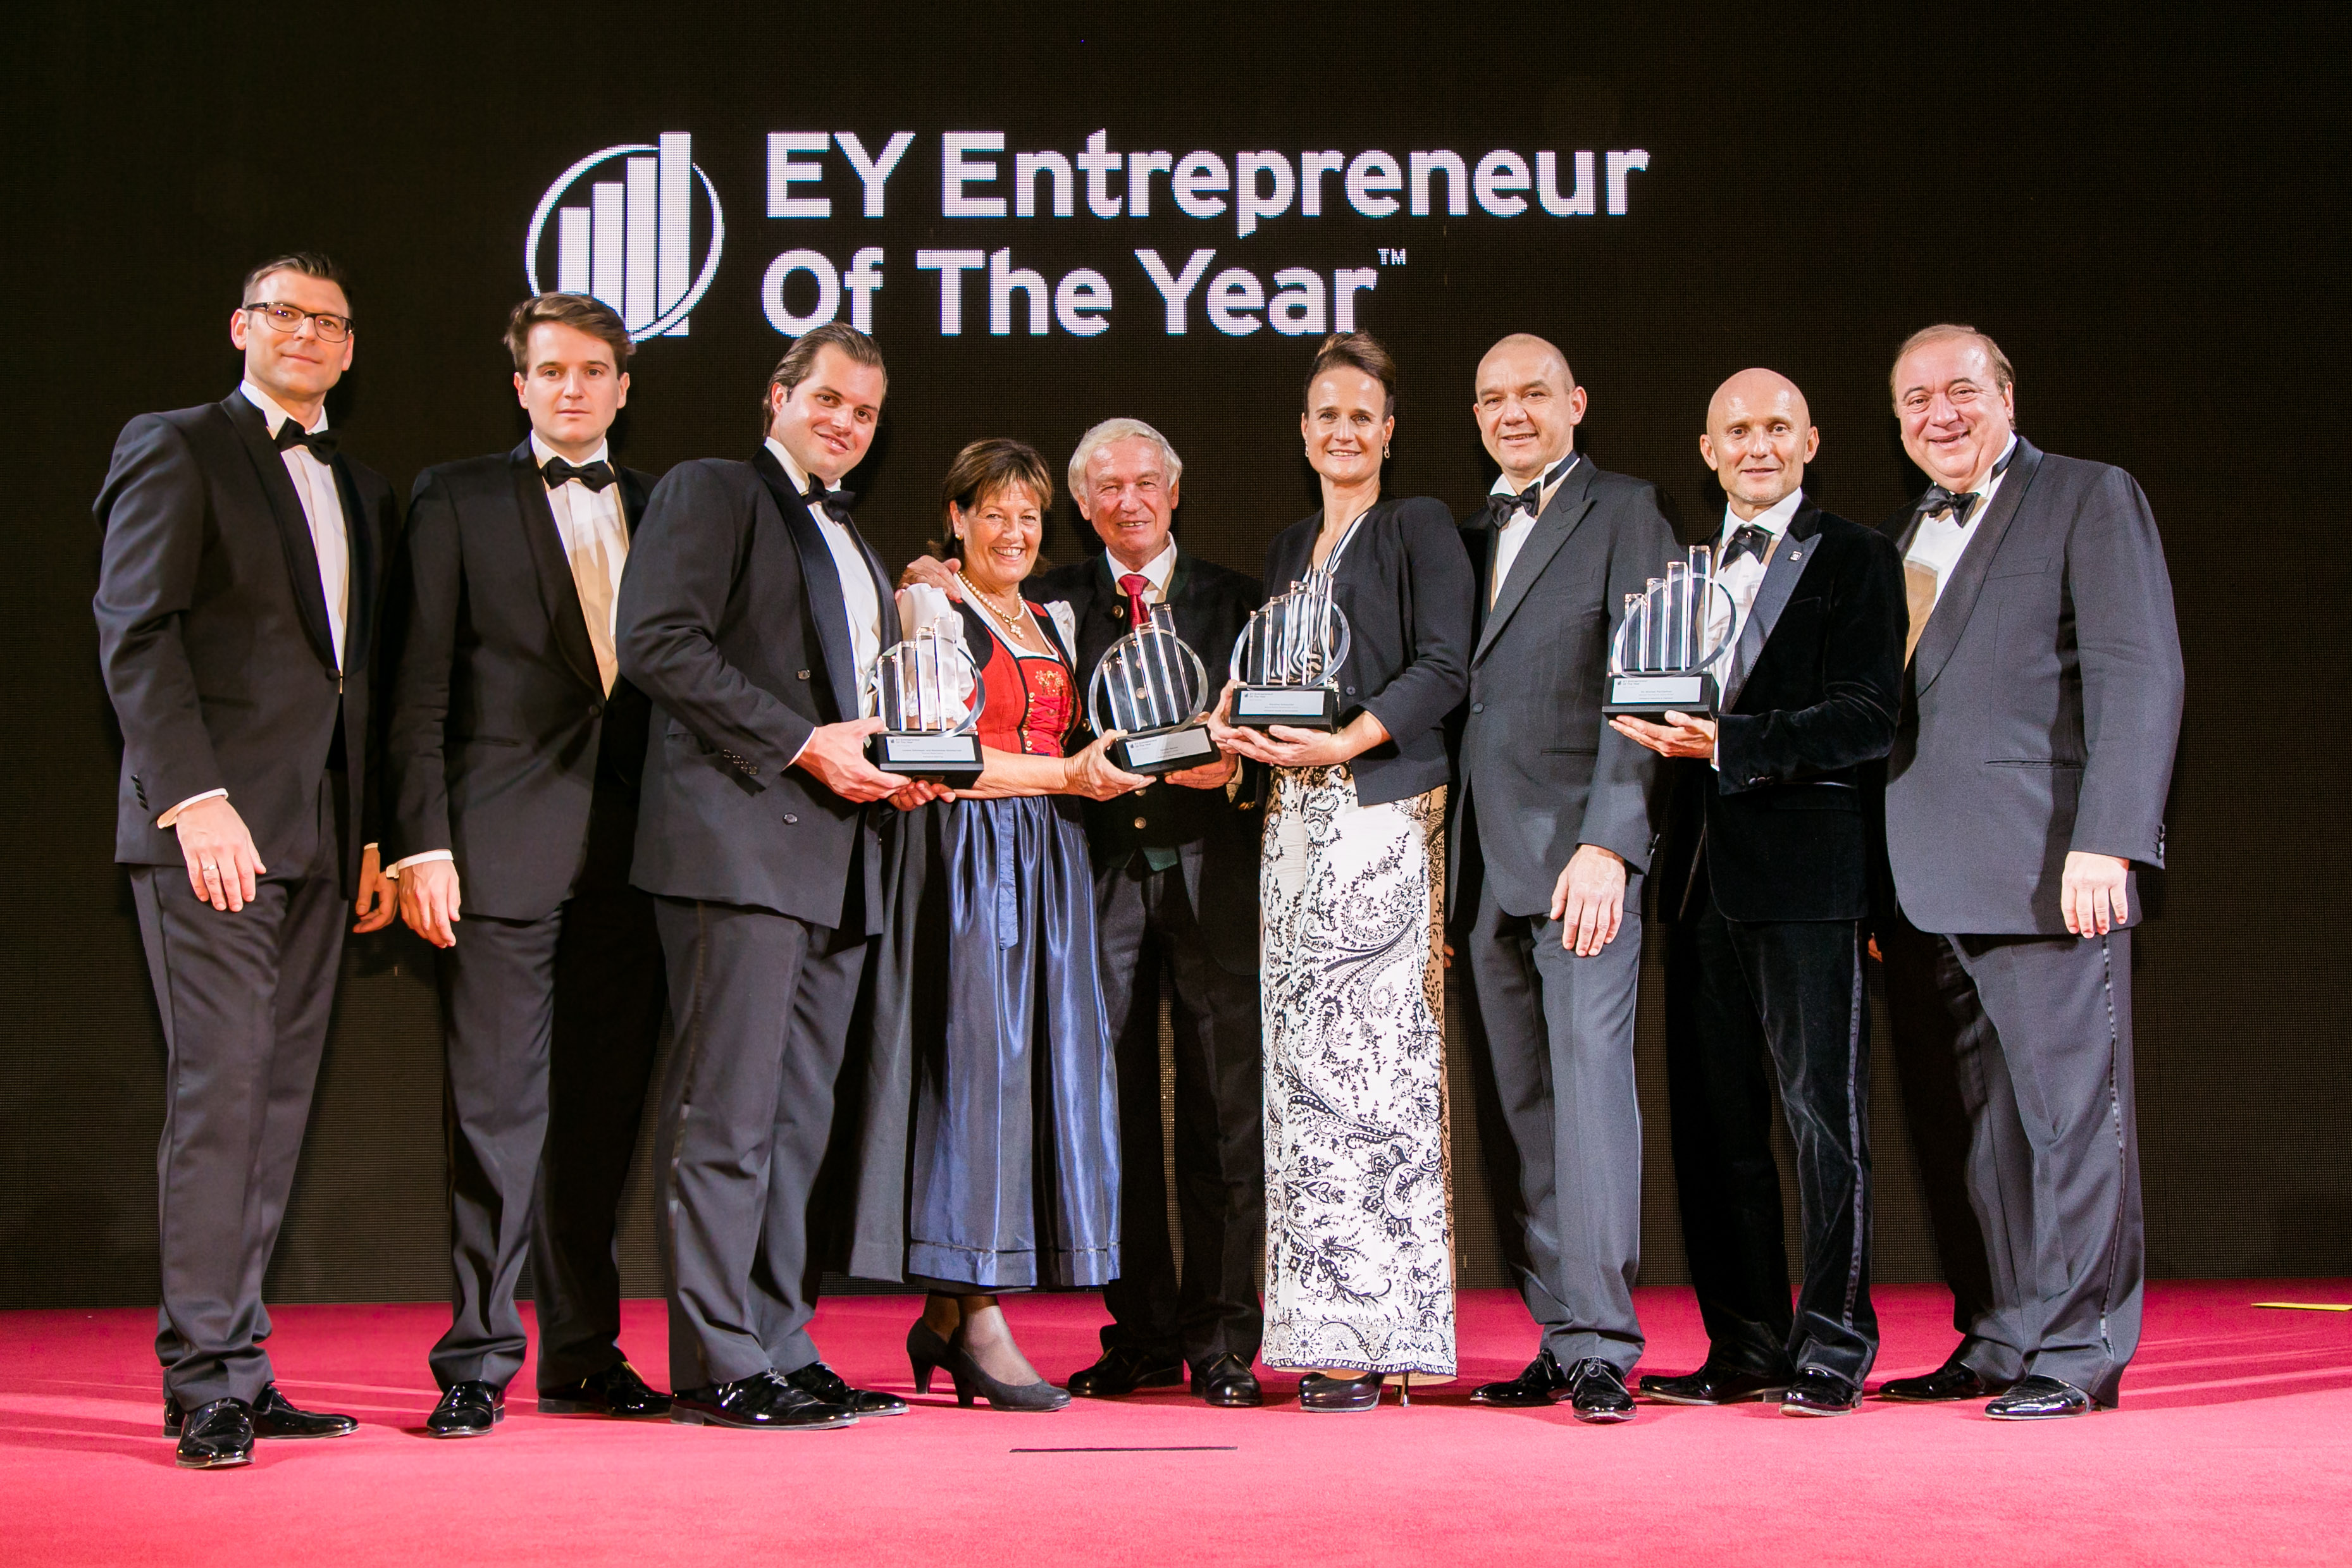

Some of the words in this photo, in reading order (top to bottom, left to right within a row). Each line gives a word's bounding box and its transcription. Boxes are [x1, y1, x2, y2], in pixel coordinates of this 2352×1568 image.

[767, 131, 915, 218] EY
[942, 128, 1650, 238] Entrepreneur
[762, 247, 884, 338] Of
[916, 247, 1113, 336] The
